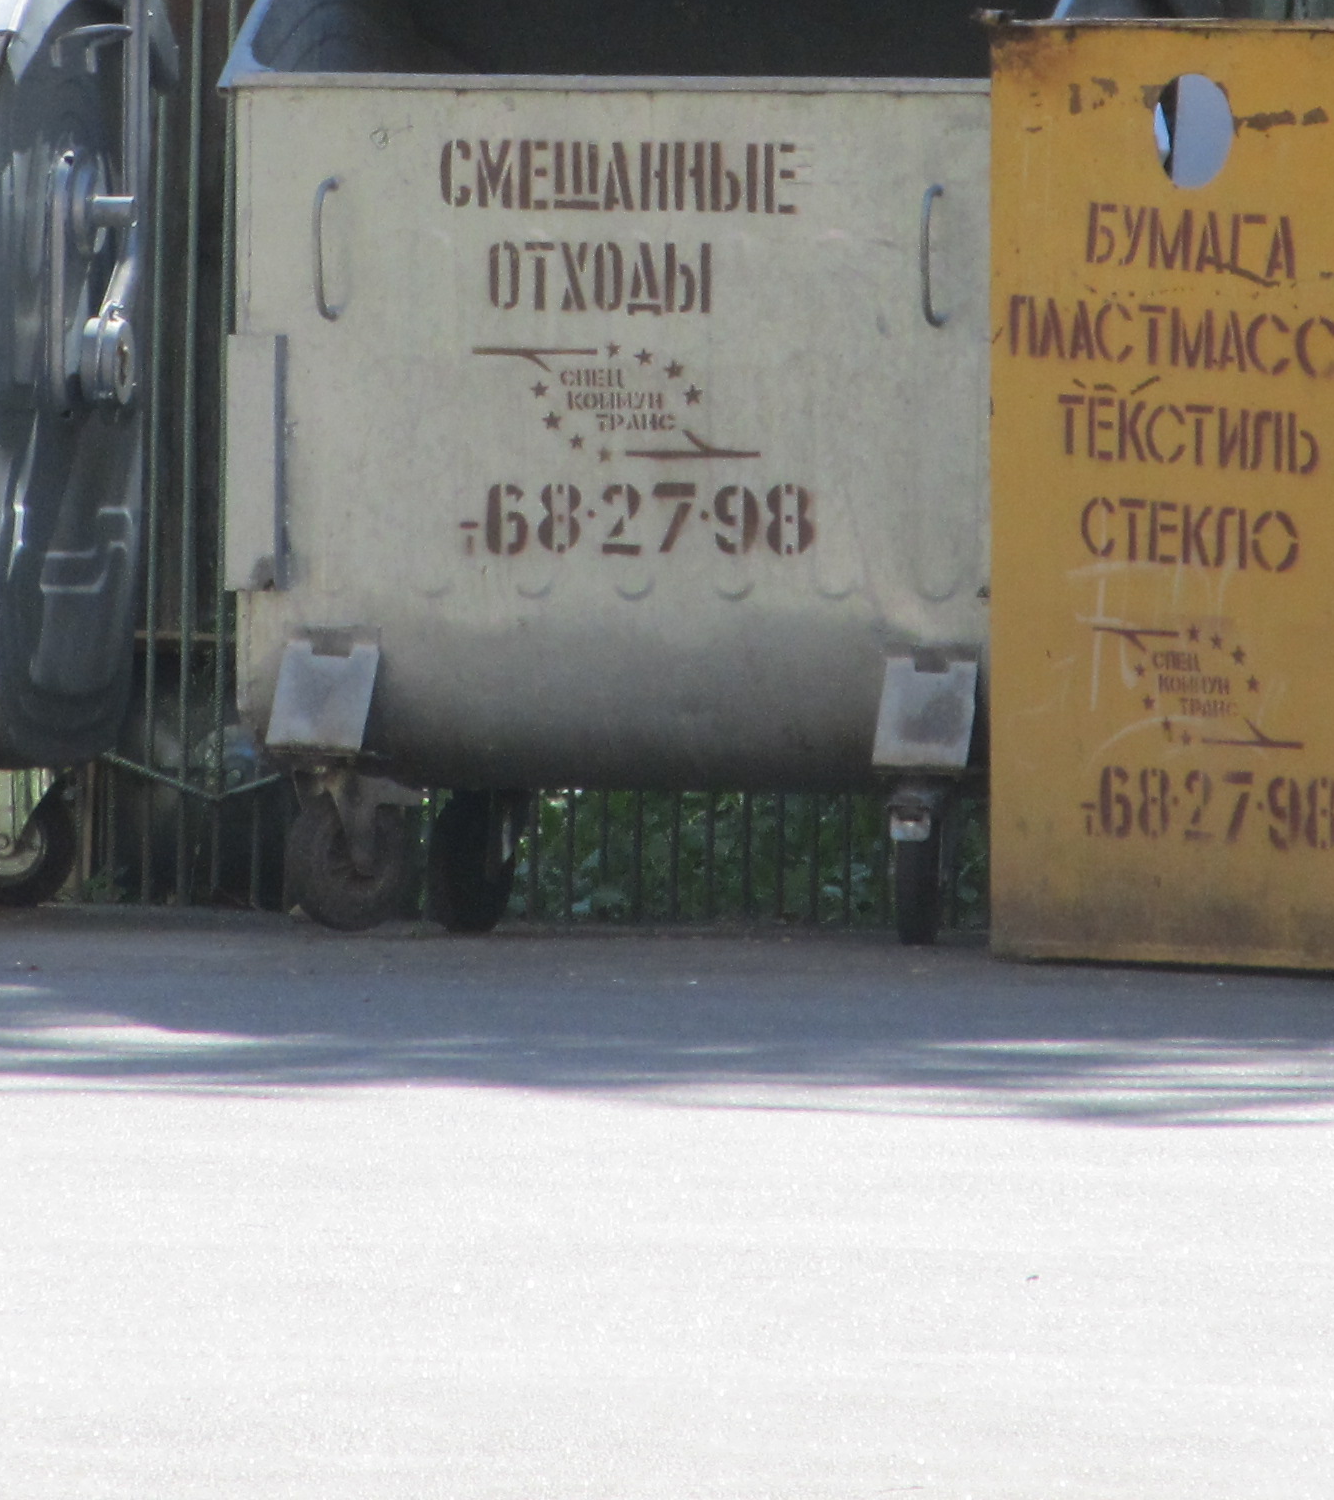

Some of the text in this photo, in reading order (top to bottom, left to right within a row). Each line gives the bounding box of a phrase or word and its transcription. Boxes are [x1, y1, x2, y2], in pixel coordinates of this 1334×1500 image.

[439, 139, 799, 214] СМЕШАННЫЕ
[488, 241, 712, 316] ОТХОДЫ
[1085, 201, 1296, 280] БУМАГА
[1058, 393, 1320, 475] ТЕКСТИЛЬ
[1080, 497, 1300, 574] СТЕКЛО
